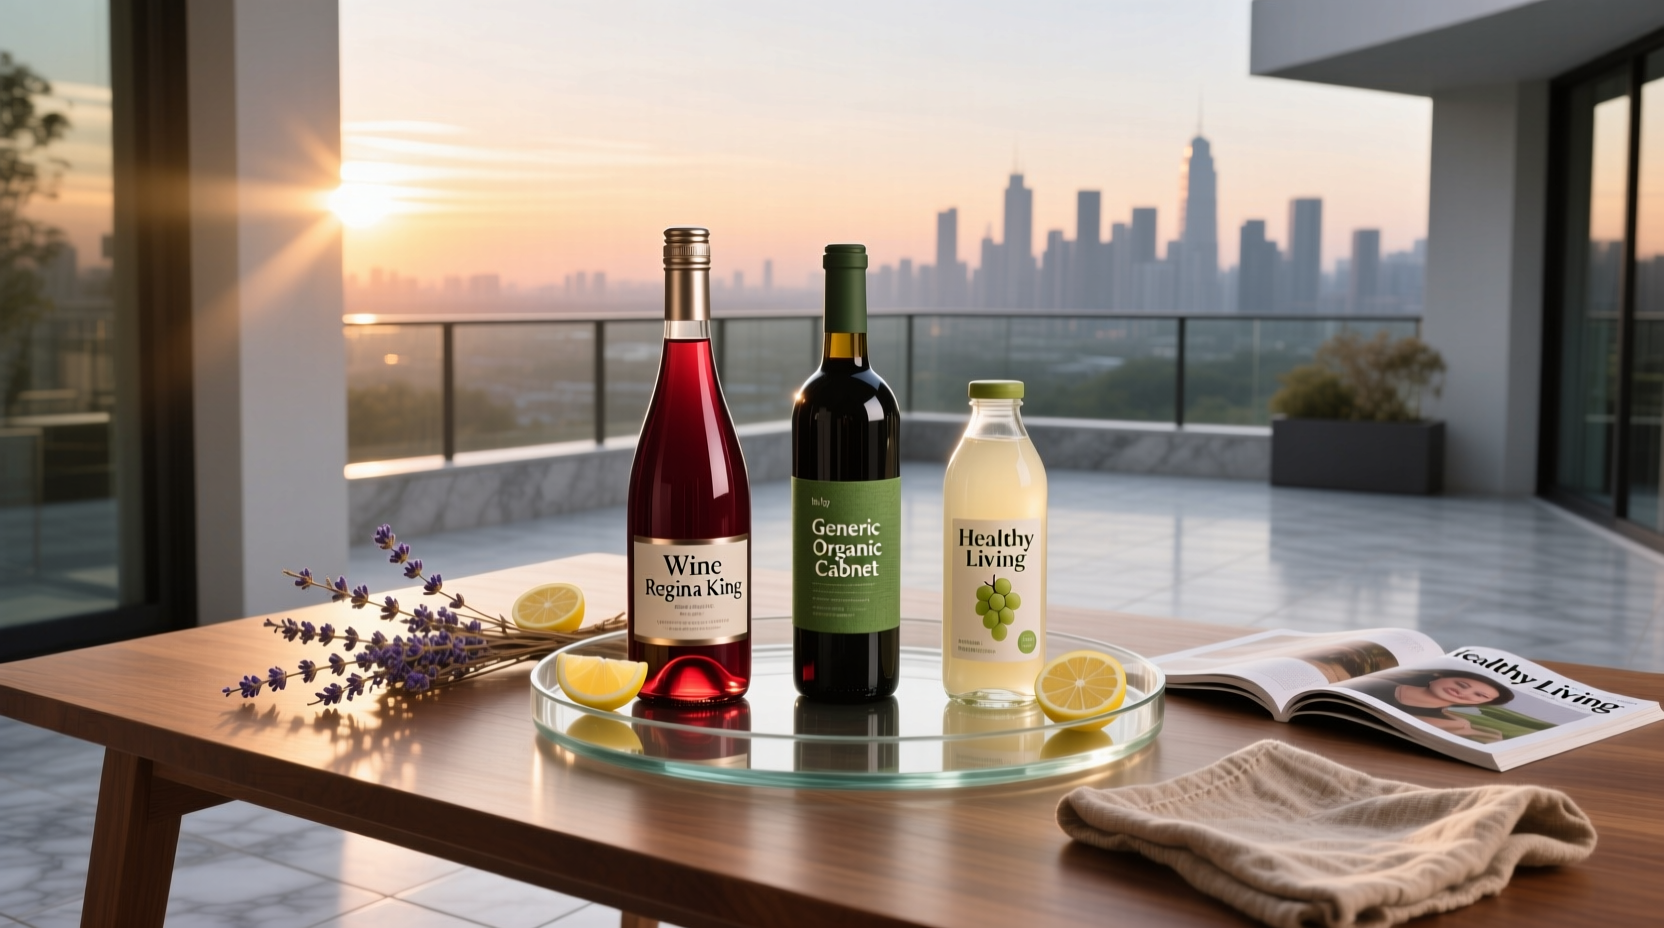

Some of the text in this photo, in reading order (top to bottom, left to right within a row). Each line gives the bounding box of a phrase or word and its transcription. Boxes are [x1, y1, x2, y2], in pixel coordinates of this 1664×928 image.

[812, 518, 881, 537] Generic
[812, 538, 882, 561] Organic
[958, 528, 1034, 552] Healthy
[662, 554, 722, 576] Wine
[814, 559, 880, 578] Cabnet
[966, 549, 1028, 573] Living
[645, 577, 743, 603] Regina King
[1532, 680, 1622, 714] Living
